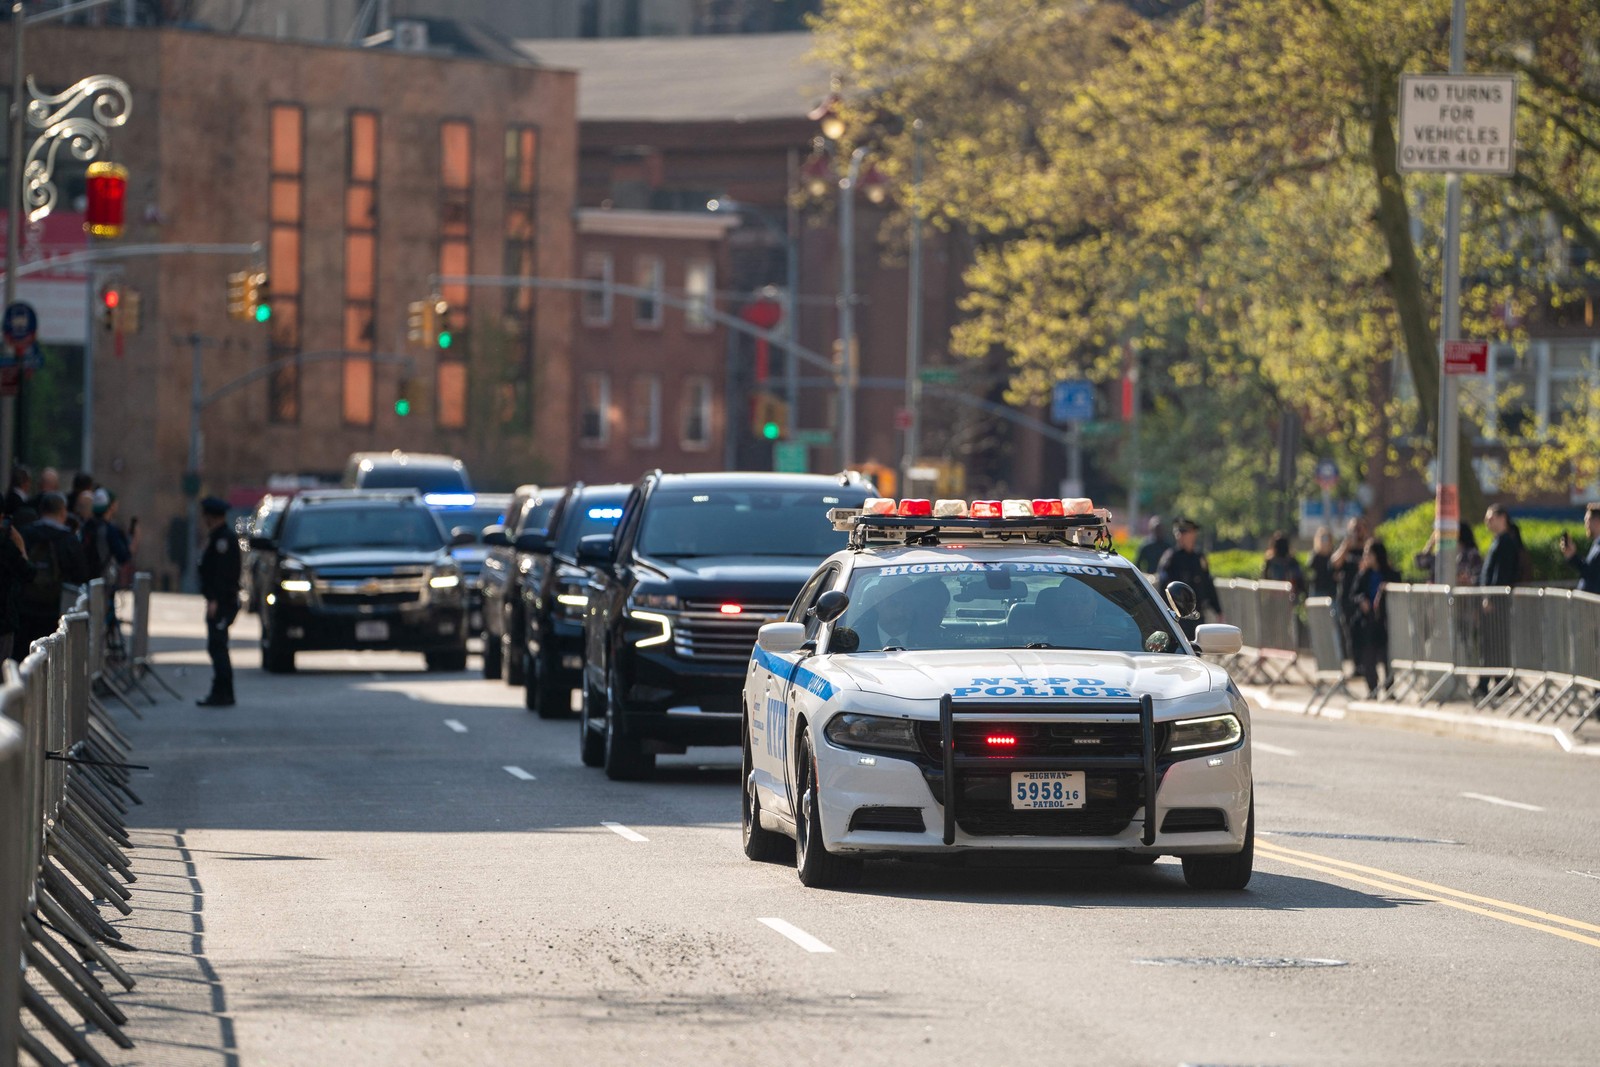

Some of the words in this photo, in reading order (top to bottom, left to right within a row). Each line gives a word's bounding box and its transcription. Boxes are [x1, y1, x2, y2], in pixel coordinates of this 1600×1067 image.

[1413, 84, 1439, 100] NO
[1445, 84, 1502, 101] TURNS
[1439, 105, 1474, 122] FOR
[1414, 126, 1499, 145] VEHICLES
[1403, 146, 1449, 163] OVER
[1455, 147, 1480, 165] 40
[1486, 149, 1506, 165] FT
[879, 562, 1003, 577] HIGHWAY
[1016, 562, 1116, 578] PATROL
[970, 677, 1106, 686] NYPD
[952, 686, 1132, 697] POLICE
[1017, 782, 1063, 800] 5958
[1065, 790, 1079, 800] 16
